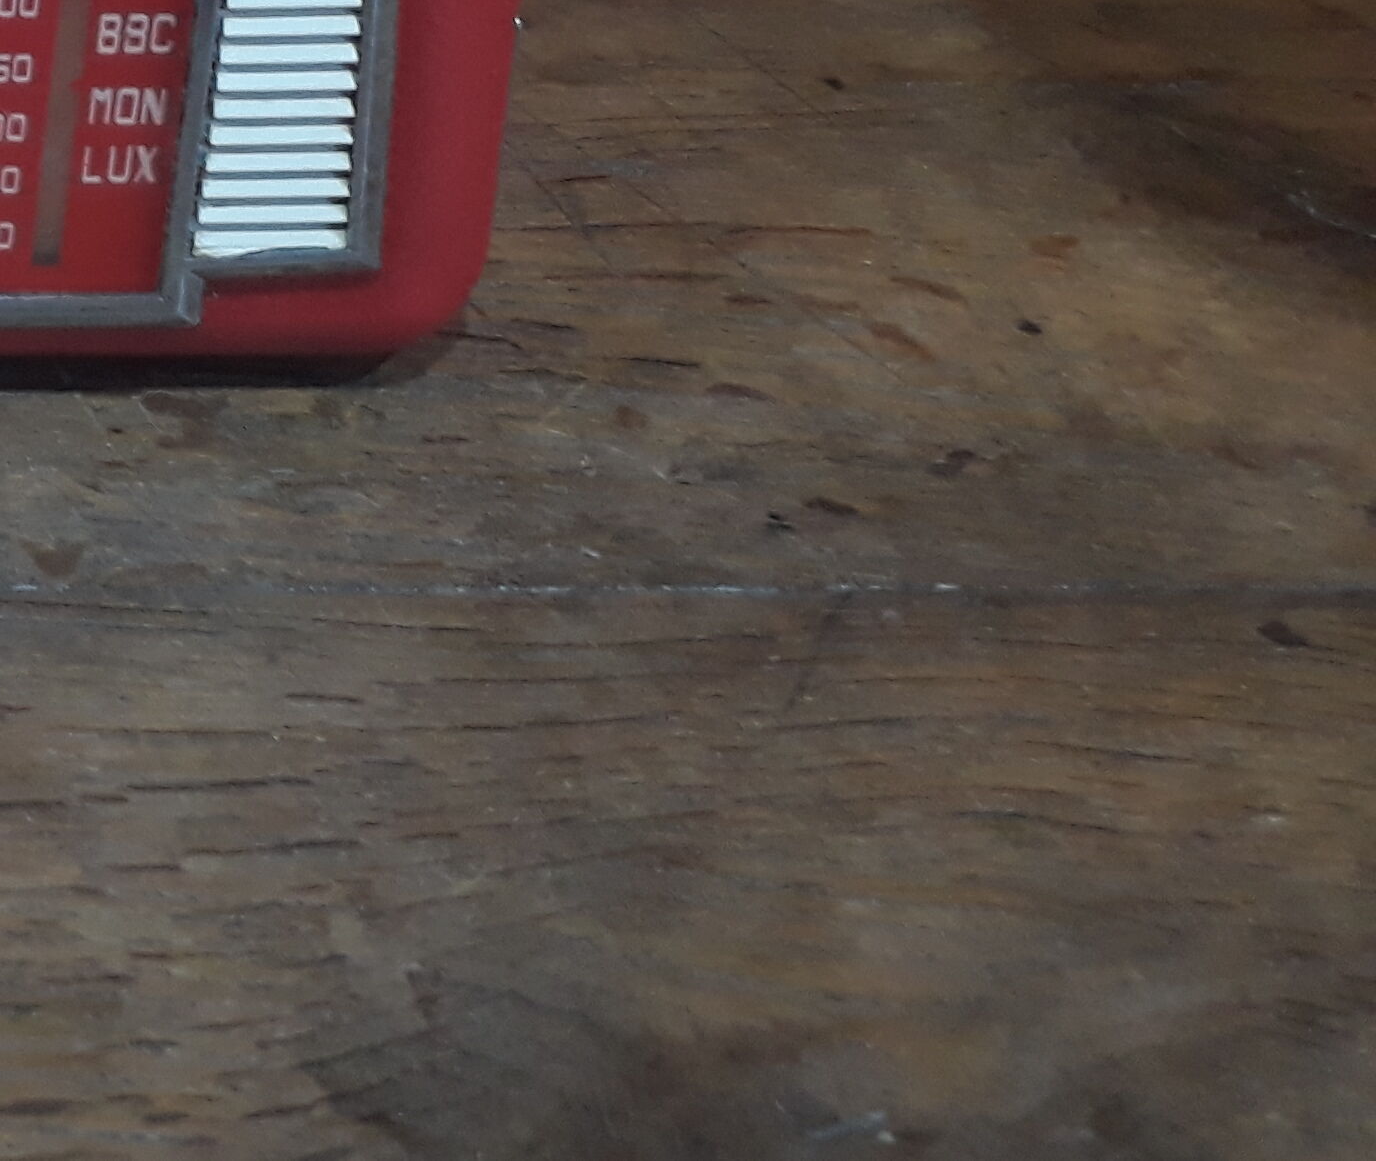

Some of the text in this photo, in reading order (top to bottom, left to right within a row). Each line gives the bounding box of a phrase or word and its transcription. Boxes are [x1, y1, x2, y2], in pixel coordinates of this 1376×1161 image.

[95, 12, 178, 55] BBC
[88, 86, 167, 127] MON
[81, 145, 159, 184] LUX
